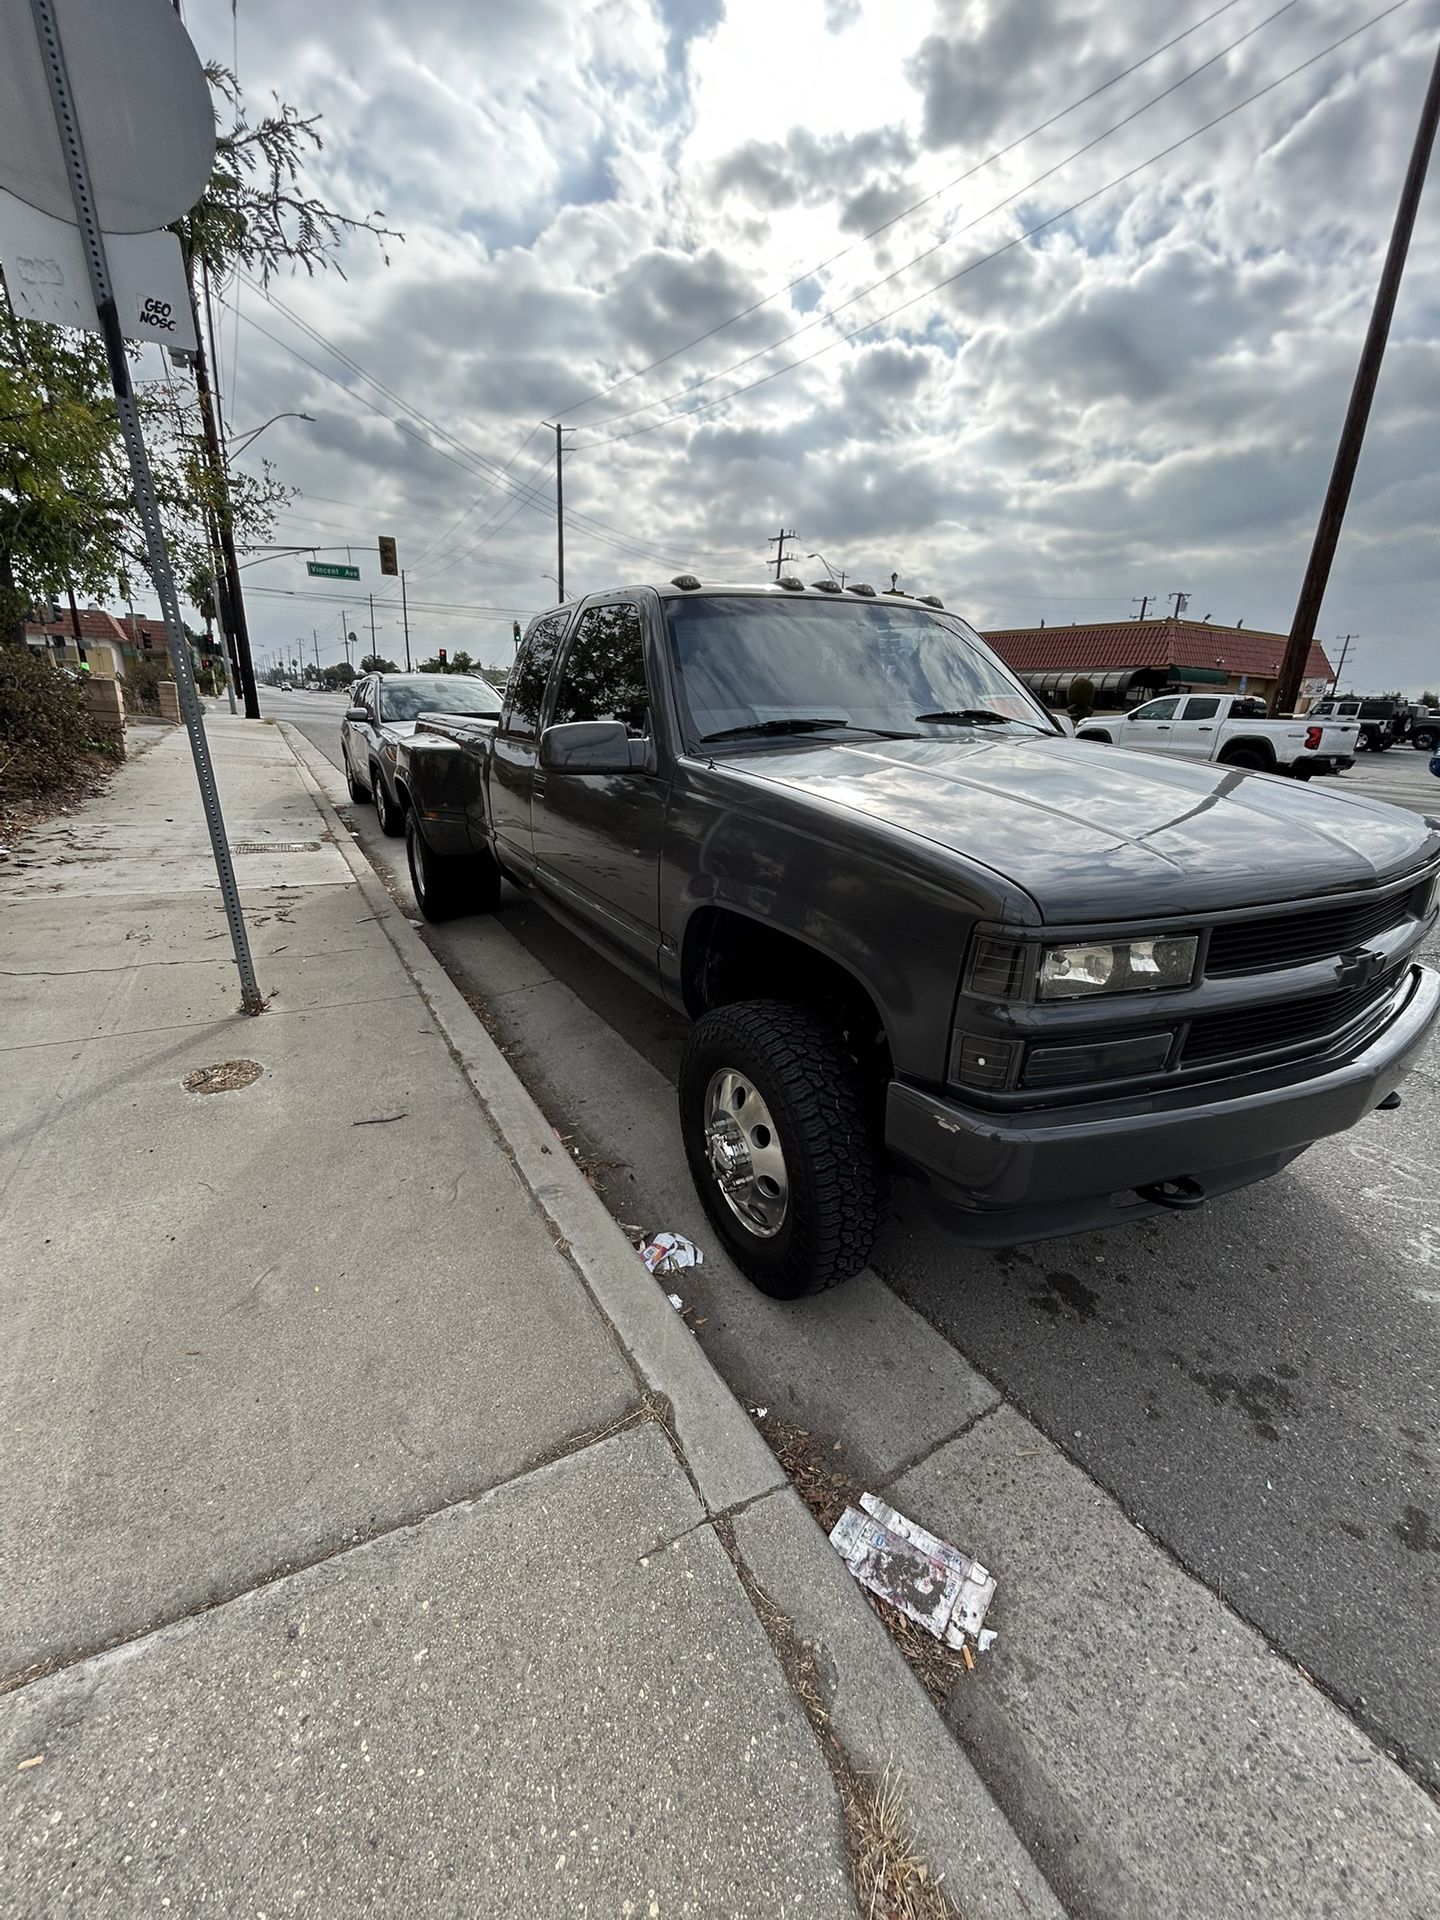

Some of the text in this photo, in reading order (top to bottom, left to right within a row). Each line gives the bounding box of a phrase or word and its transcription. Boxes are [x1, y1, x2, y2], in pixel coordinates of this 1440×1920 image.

[145, 297, 172, 317] GEO
[139, 311, 176, 331] NOSC
[310, 565, 358, 578] Vincent Ave
